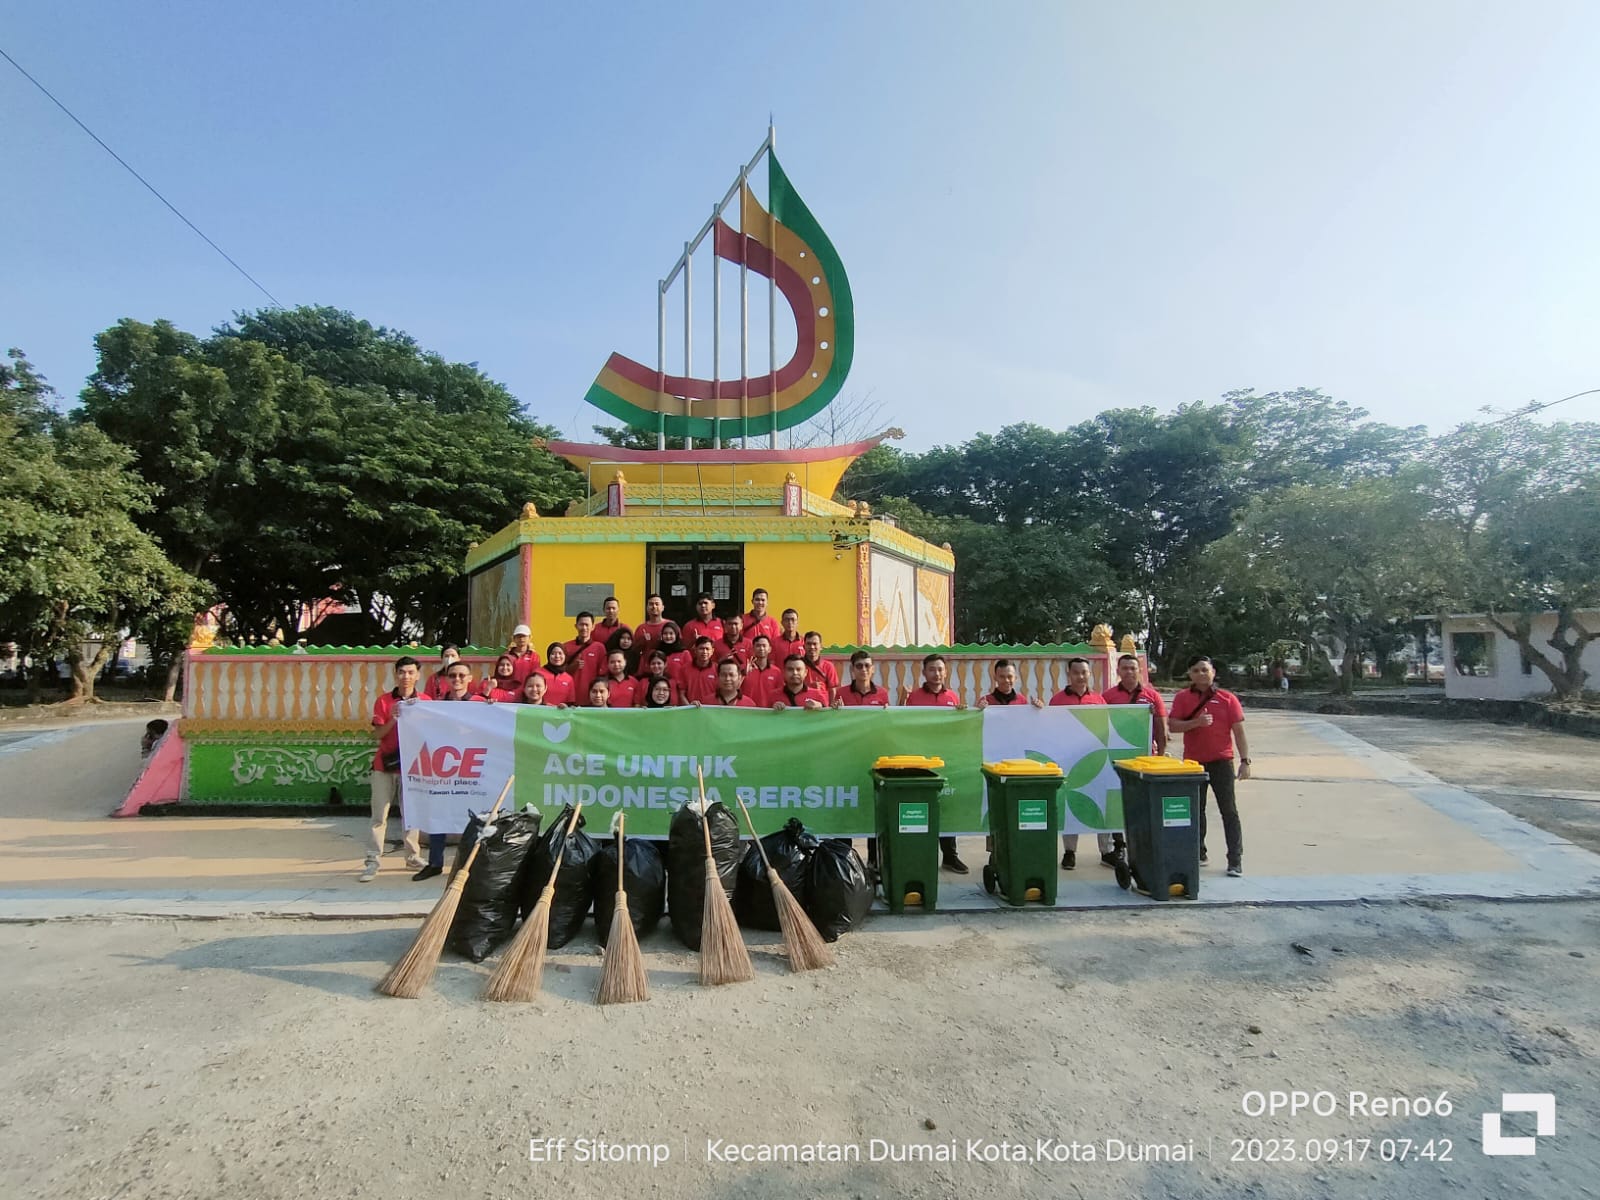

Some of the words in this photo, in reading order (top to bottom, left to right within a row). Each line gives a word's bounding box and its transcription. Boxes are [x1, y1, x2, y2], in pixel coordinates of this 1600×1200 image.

[408, 741, 488, 778] ACE
[543, 753, 606, 777] ACE
[616, 755, 738, 778] UNTUK
[407, 775, 421, 783] The
[735, 785, 859, 809] BERSIH
